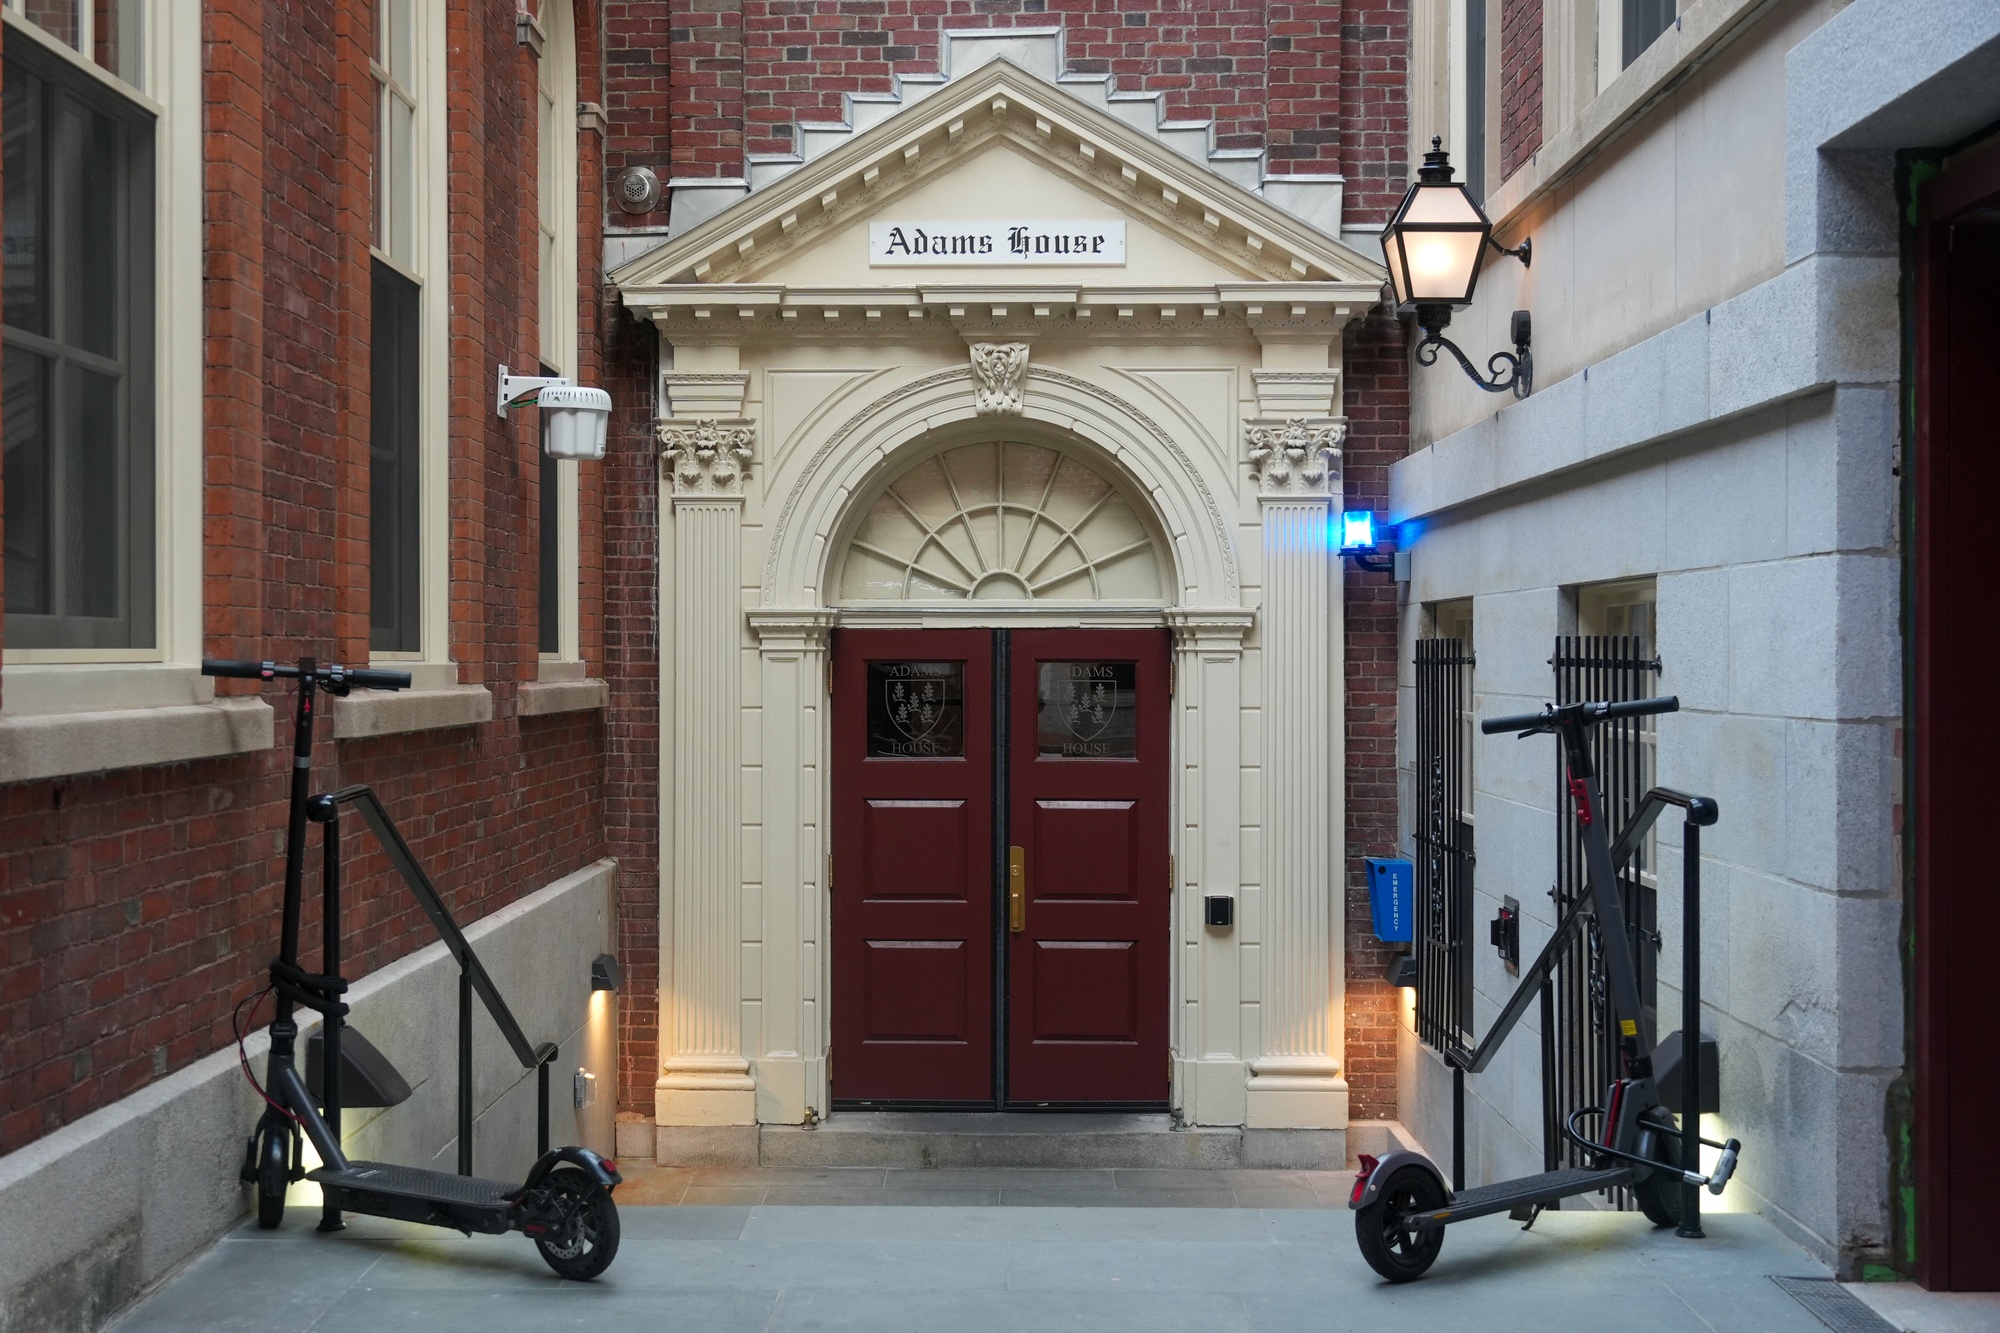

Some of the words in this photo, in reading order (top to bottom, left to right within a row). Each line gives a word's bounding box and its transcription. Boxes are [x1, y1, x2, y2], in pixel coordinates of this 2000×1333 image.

[885, 226, 993, 256] Adams
[1008, 226, 1105, 260] House
[889, 665, 942, 678] ADAMS
[1061, 665, 1114, 678] ADAMS
[892, 742, 940, 755] HOUSE
[1063, 742, 1111, 755] HOUSE
